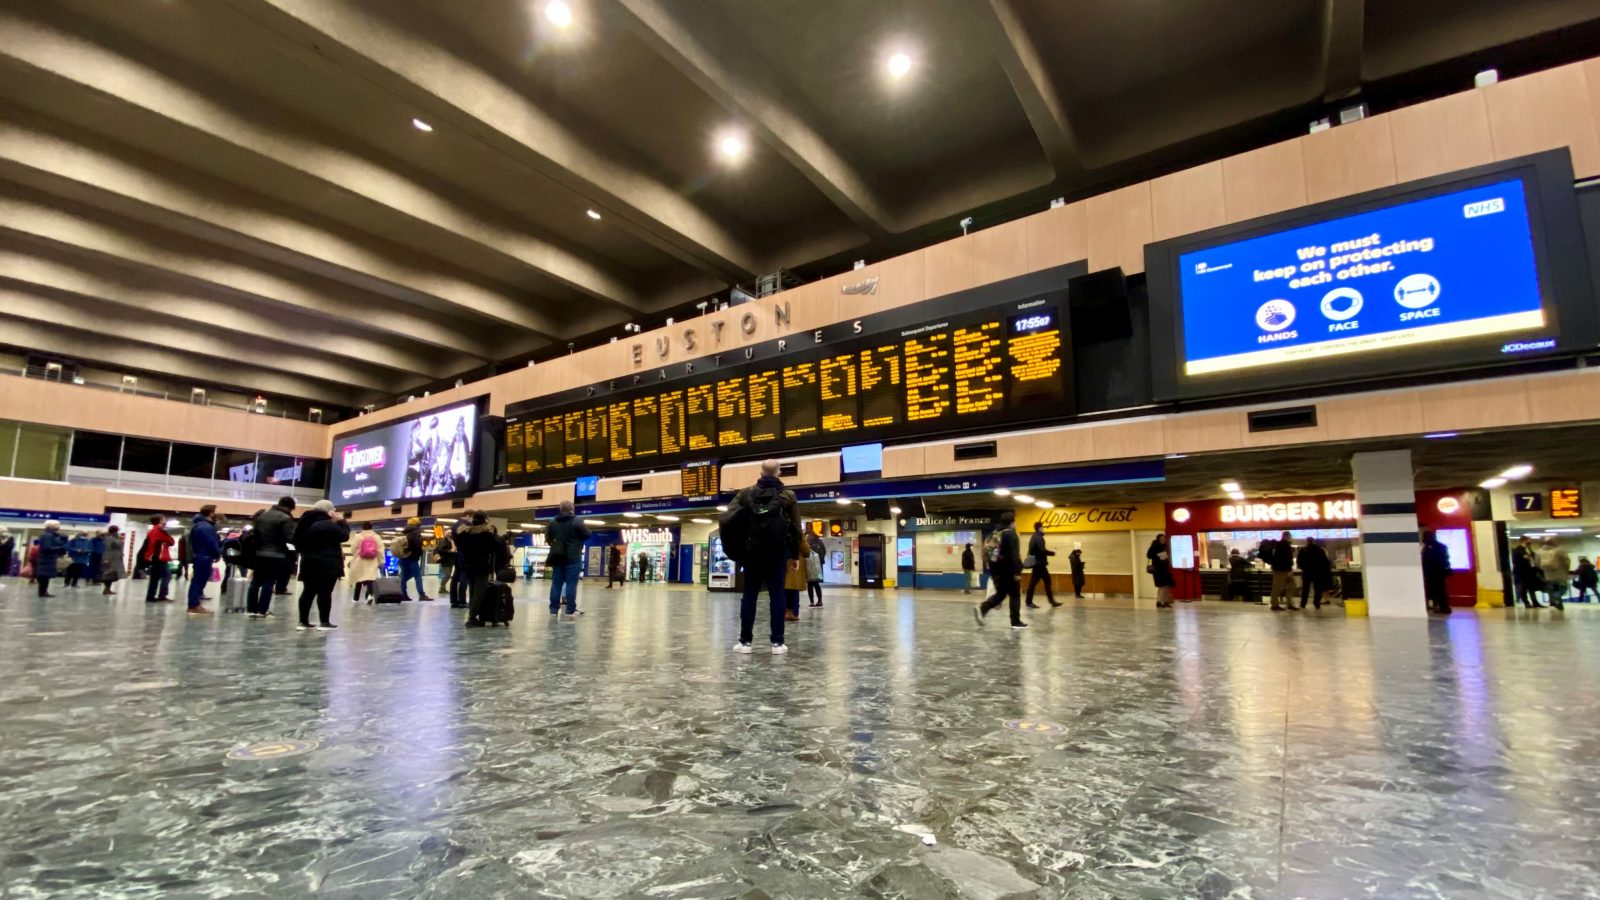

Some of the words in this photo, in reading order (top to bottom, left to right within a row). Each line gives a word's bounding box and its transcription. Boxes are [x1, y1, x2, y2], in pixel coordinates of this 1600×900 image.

[1468, 200, 1500, 215] NHS
[1296, 246, 1326, 260] We
[1330, 233, 1381, 253] must
[1253, 265, 1296, 283] keep
[1300, 259, 1325, 273] on
[1329, 237, 1434, 270] protecting
[1289, 271, 1332, 289] each
[1336, 260, 1395, 280] other.
[1017, 300, 1046, 310] Information
[1400, 308, 1440, 322] SPACE
[632, 301, 791, 363] EUSTON
[1328, 321, 1359, 333] FACE
[1257, 330, 1298, 343] HANDS
[1500, 340, 1555, 353] JCDecaux
[587, 320, 863, 396] DEPARTURES
[1522, 496, 1535, 509] 7
[1040, 511, 1085, 528] Upper
[1087, 505, 1138, 522] Crust
[1220, 502, 1320, 522] BURGER
[945, 516, 956, 525] de
[960, 516, 991, 525] France
[621, 527, 673, 543] WHSmith
